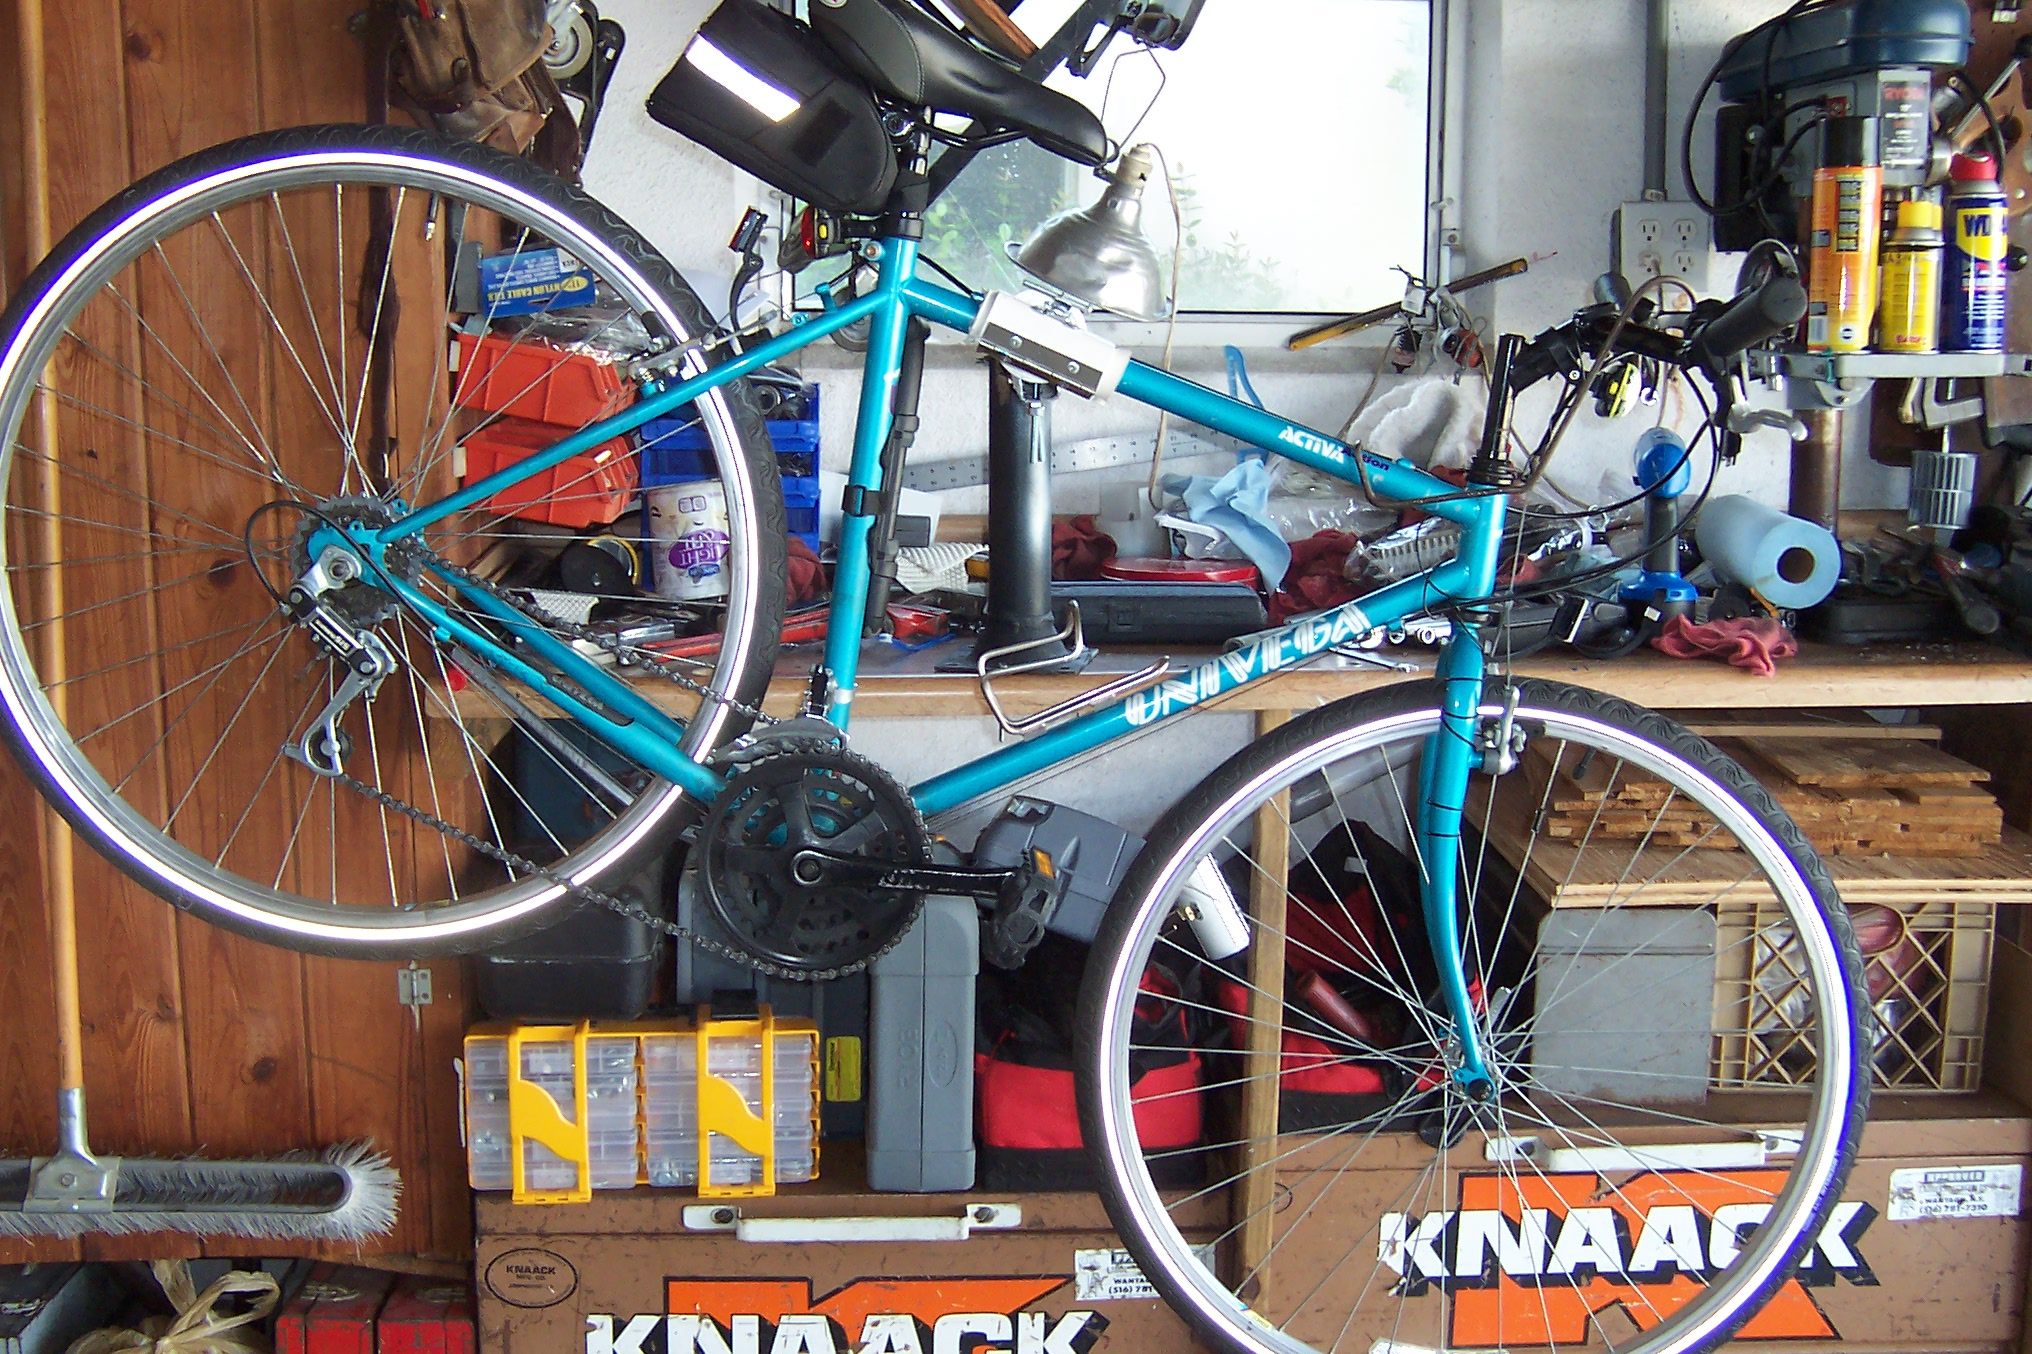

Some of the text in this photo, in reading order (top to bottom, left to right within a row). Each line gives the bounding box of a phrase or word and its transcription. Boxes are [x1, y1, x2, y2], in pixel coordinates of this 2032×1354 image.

[1278, 426, 1345, 465] ACTIVA
[680, 545, 722, 567] LIGHT
[1124, 604, 1372, 726] UNIVEGA
[1378, 1201, 1865, 1283] KNAACK
[506, 1265, 556, 1275] KNAACK
[585, 1311, 1098, 1354] KNAACK
